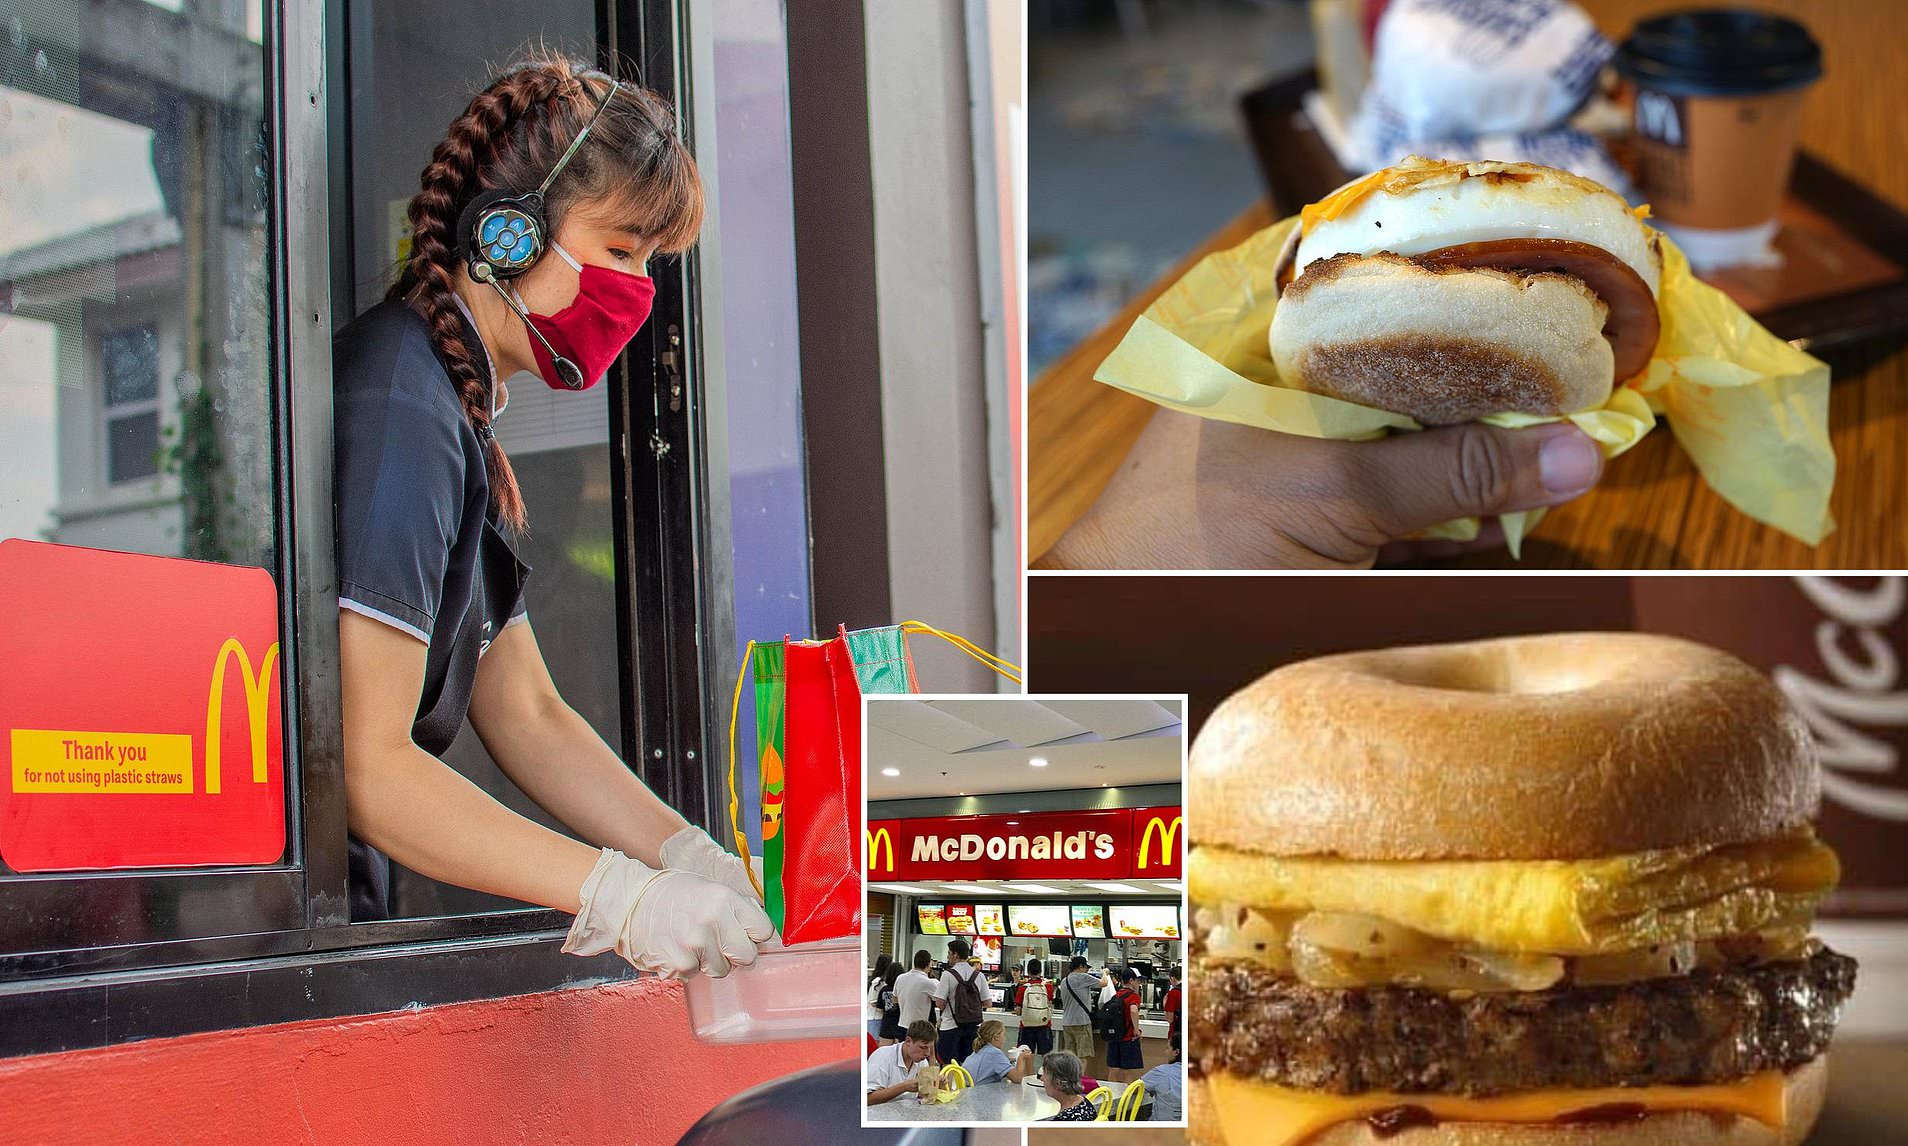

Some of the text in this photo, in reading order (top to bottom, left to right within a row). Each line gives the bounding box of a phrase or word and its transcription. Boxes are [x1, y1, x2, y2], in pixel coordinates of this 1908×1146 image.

[62, 740, 147, 767] Thank you
[24, 768, 183, 788] for not using plastic straws
[911, 831, 1115, 862] McDonald's
